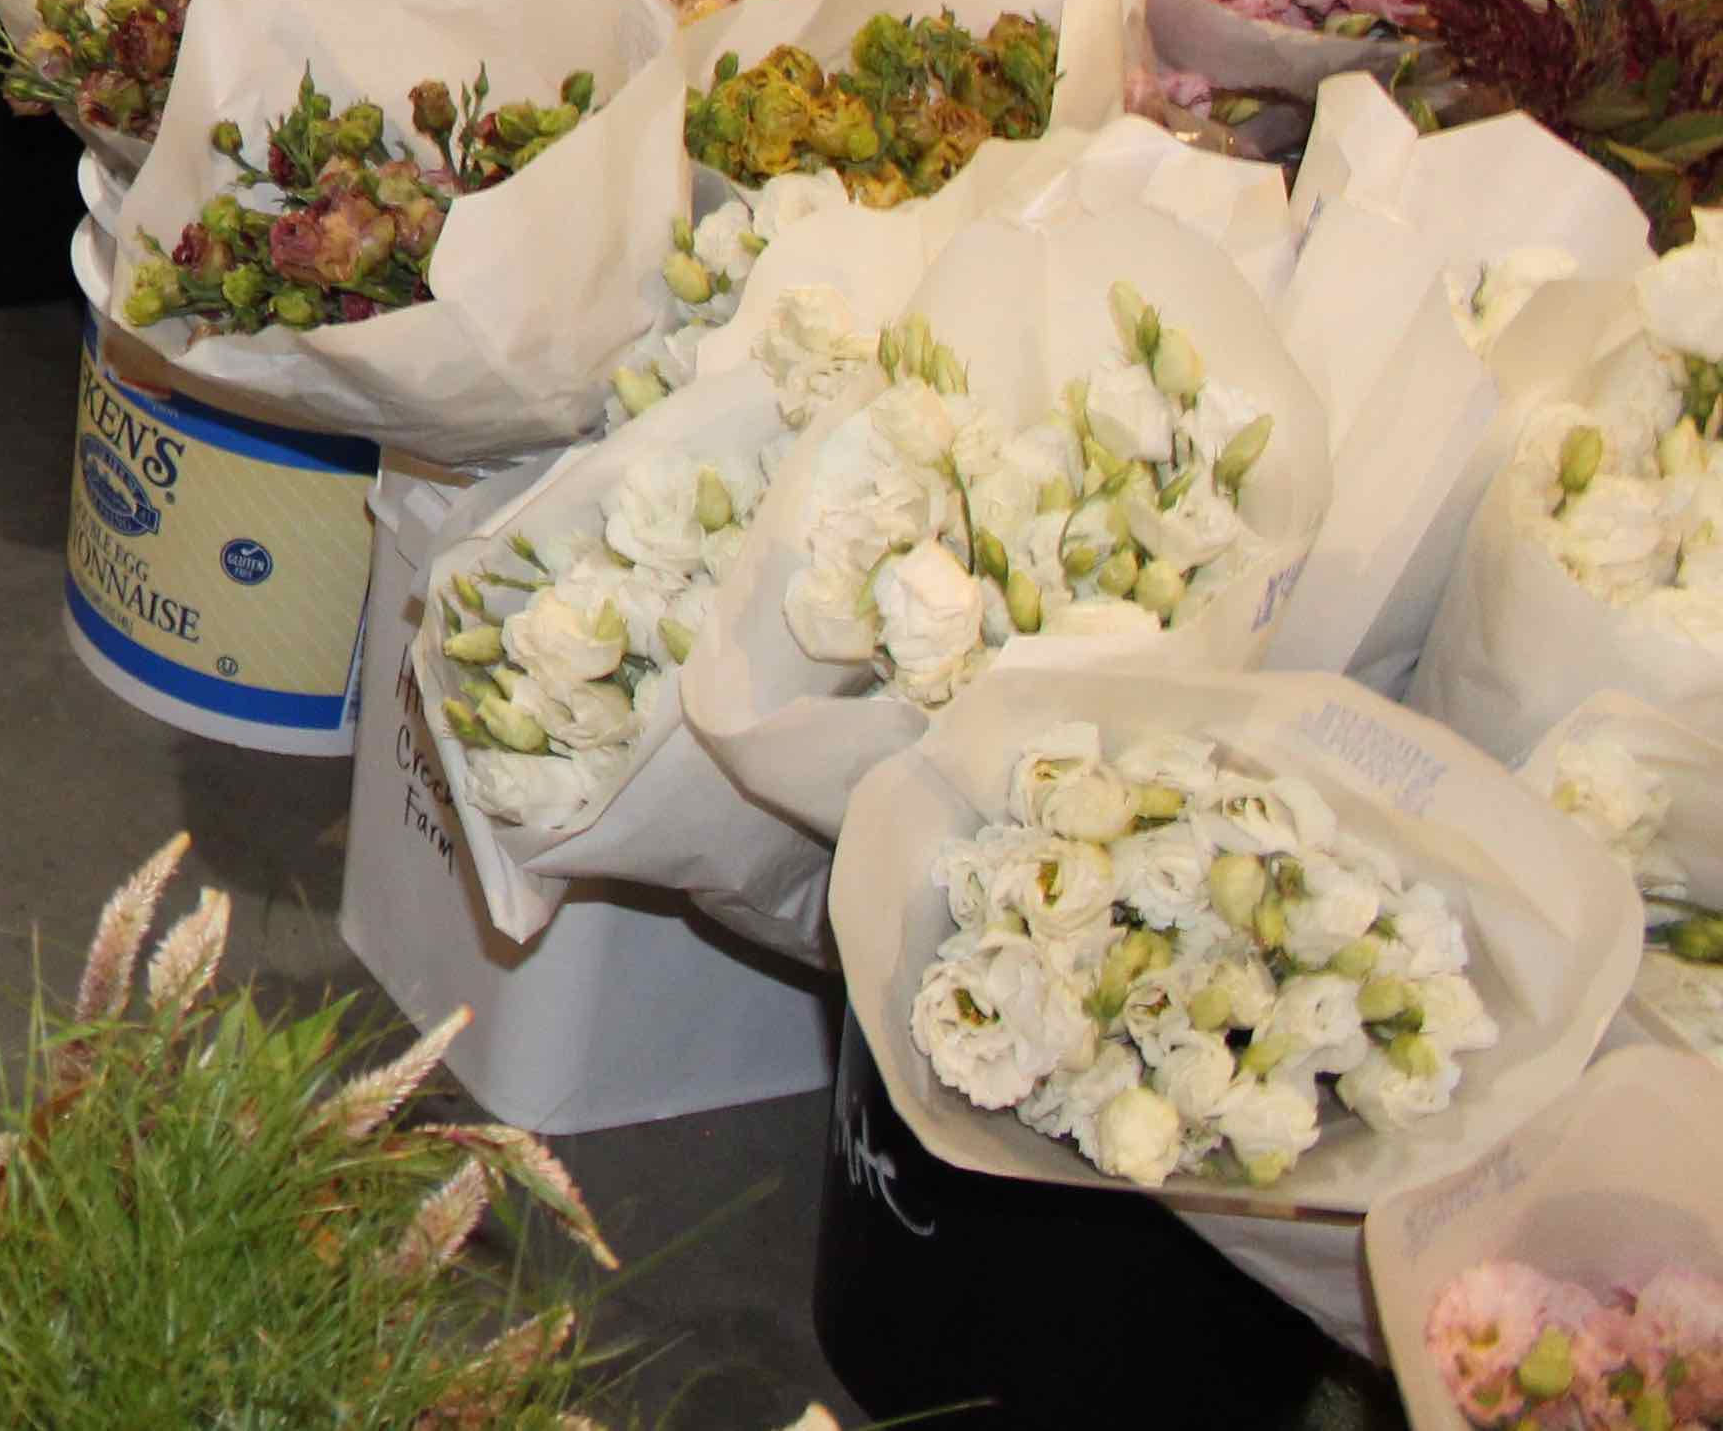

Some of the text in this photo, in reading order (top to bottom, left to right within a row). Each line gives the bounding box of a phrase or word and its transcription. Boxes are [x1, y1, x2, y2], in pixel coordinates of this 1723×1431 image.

[84, 371, 186, 488] KEN'S
[74, 529, 200, 643] ONNAISE
[226, 553, 265, 572] GLUTEN
[404, 784, 453, 875] Farm
